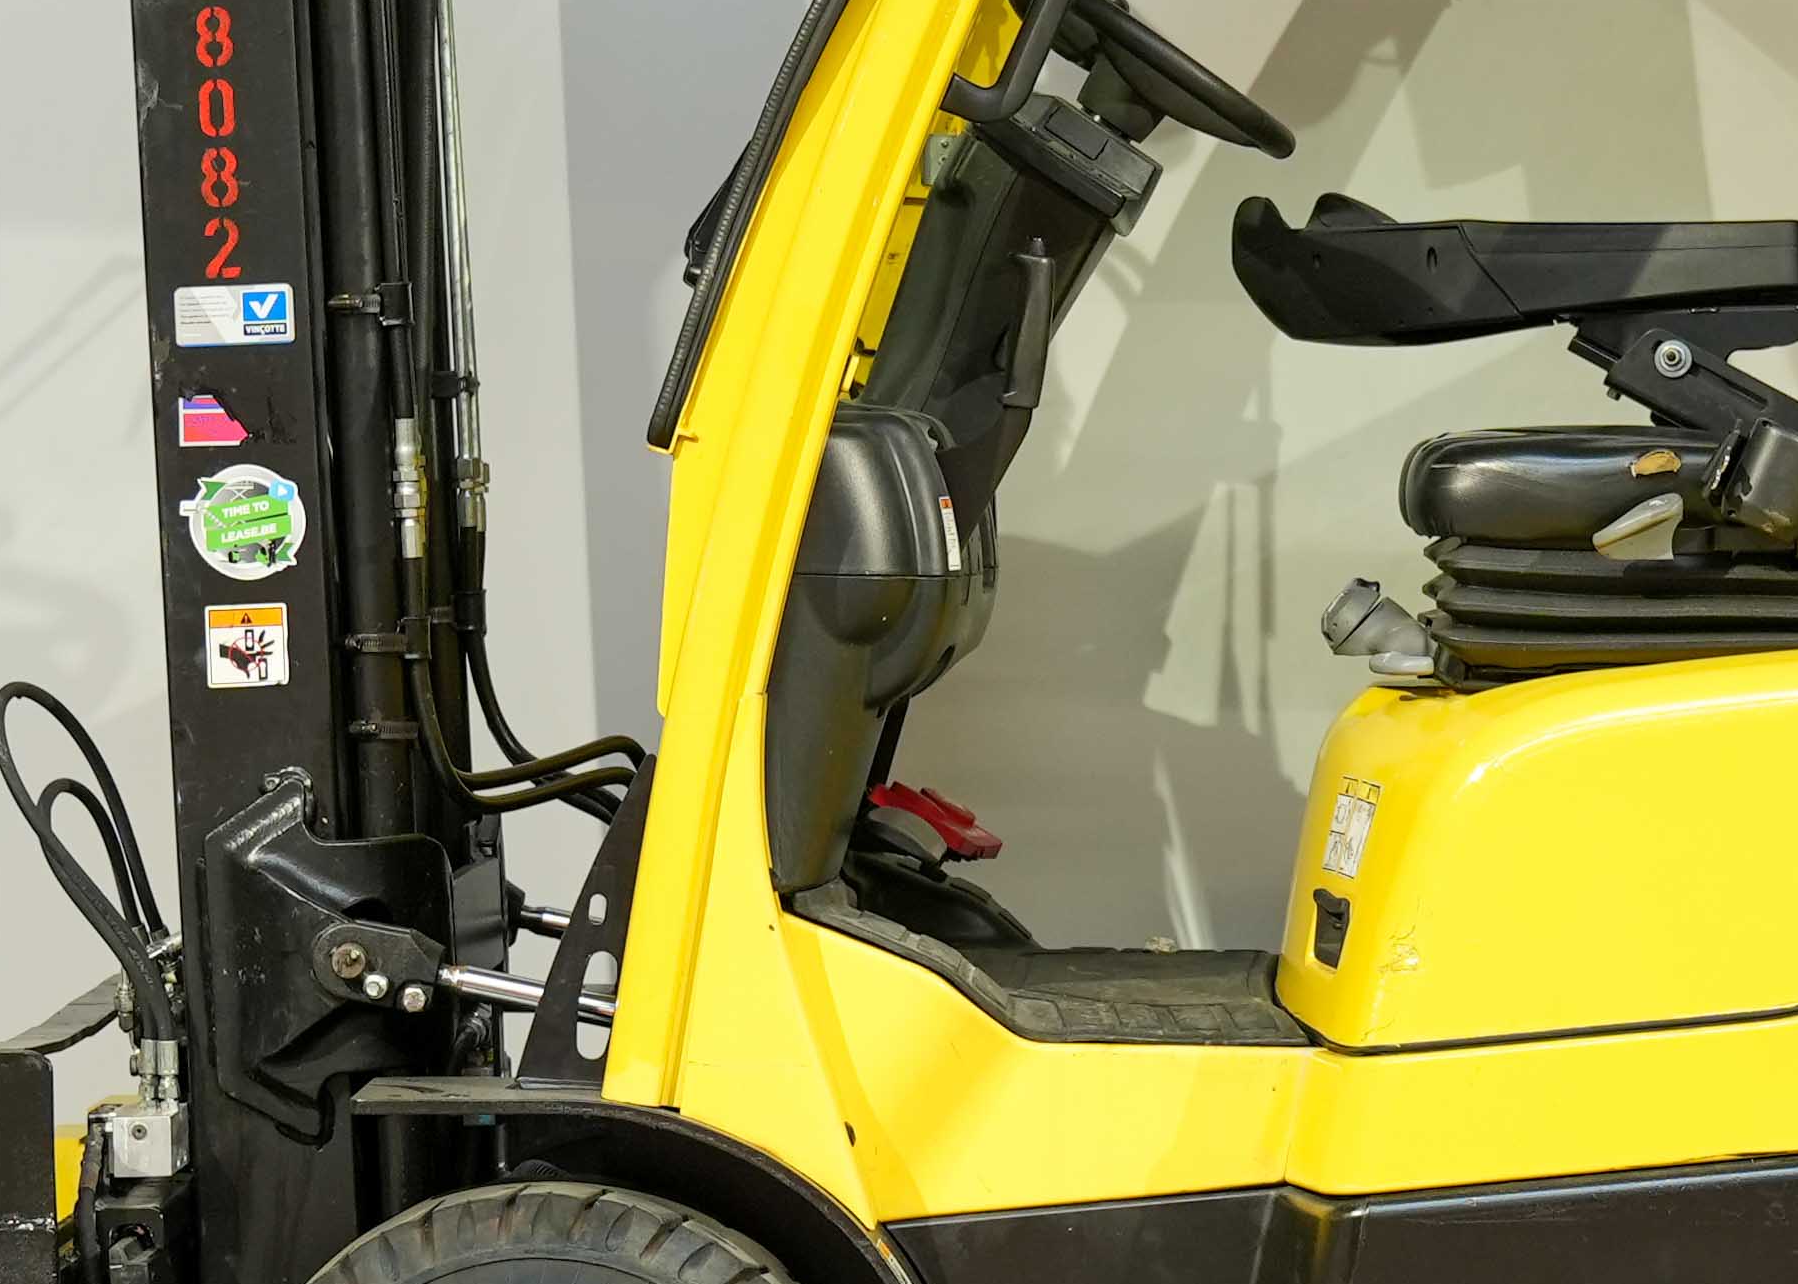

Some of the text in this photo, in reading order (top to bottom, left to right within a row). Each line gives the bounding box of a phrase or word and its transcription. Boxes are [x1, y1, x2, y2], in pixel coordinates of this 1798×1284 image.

[196, 6, 242, 279] 8082
[222, 501, 269, 518] TIME TO
